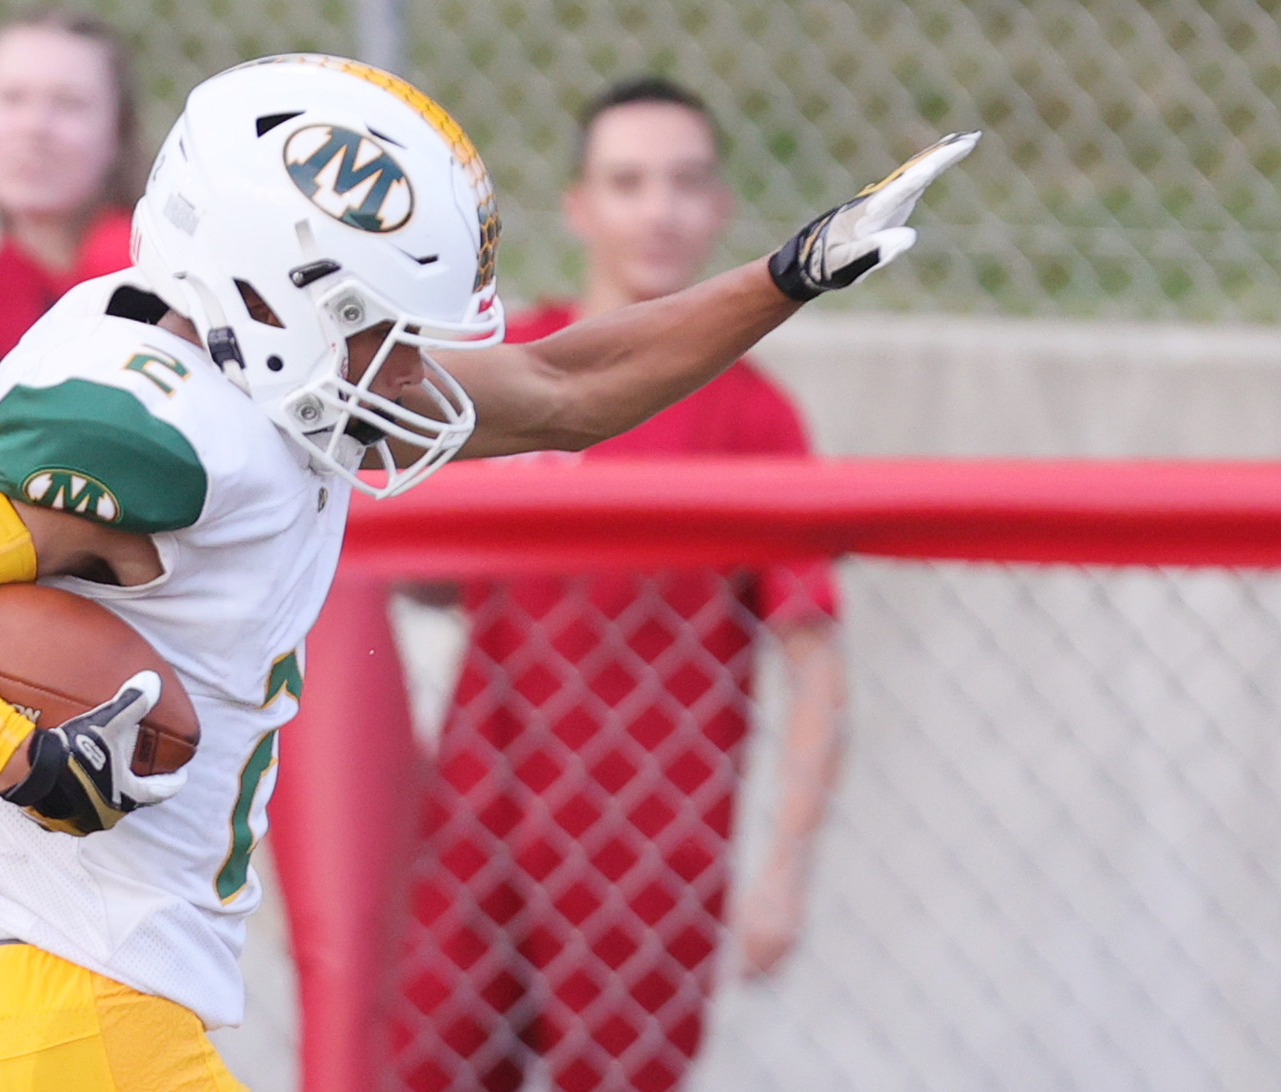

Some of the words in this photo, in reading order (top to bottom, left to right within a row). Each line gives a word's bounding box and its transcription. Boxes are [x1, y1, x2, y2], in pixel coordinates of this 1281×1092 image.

[287, 126, 405, 232] M
[121, 344, 193, 398] 2
[31, 471, 115, 521] M
